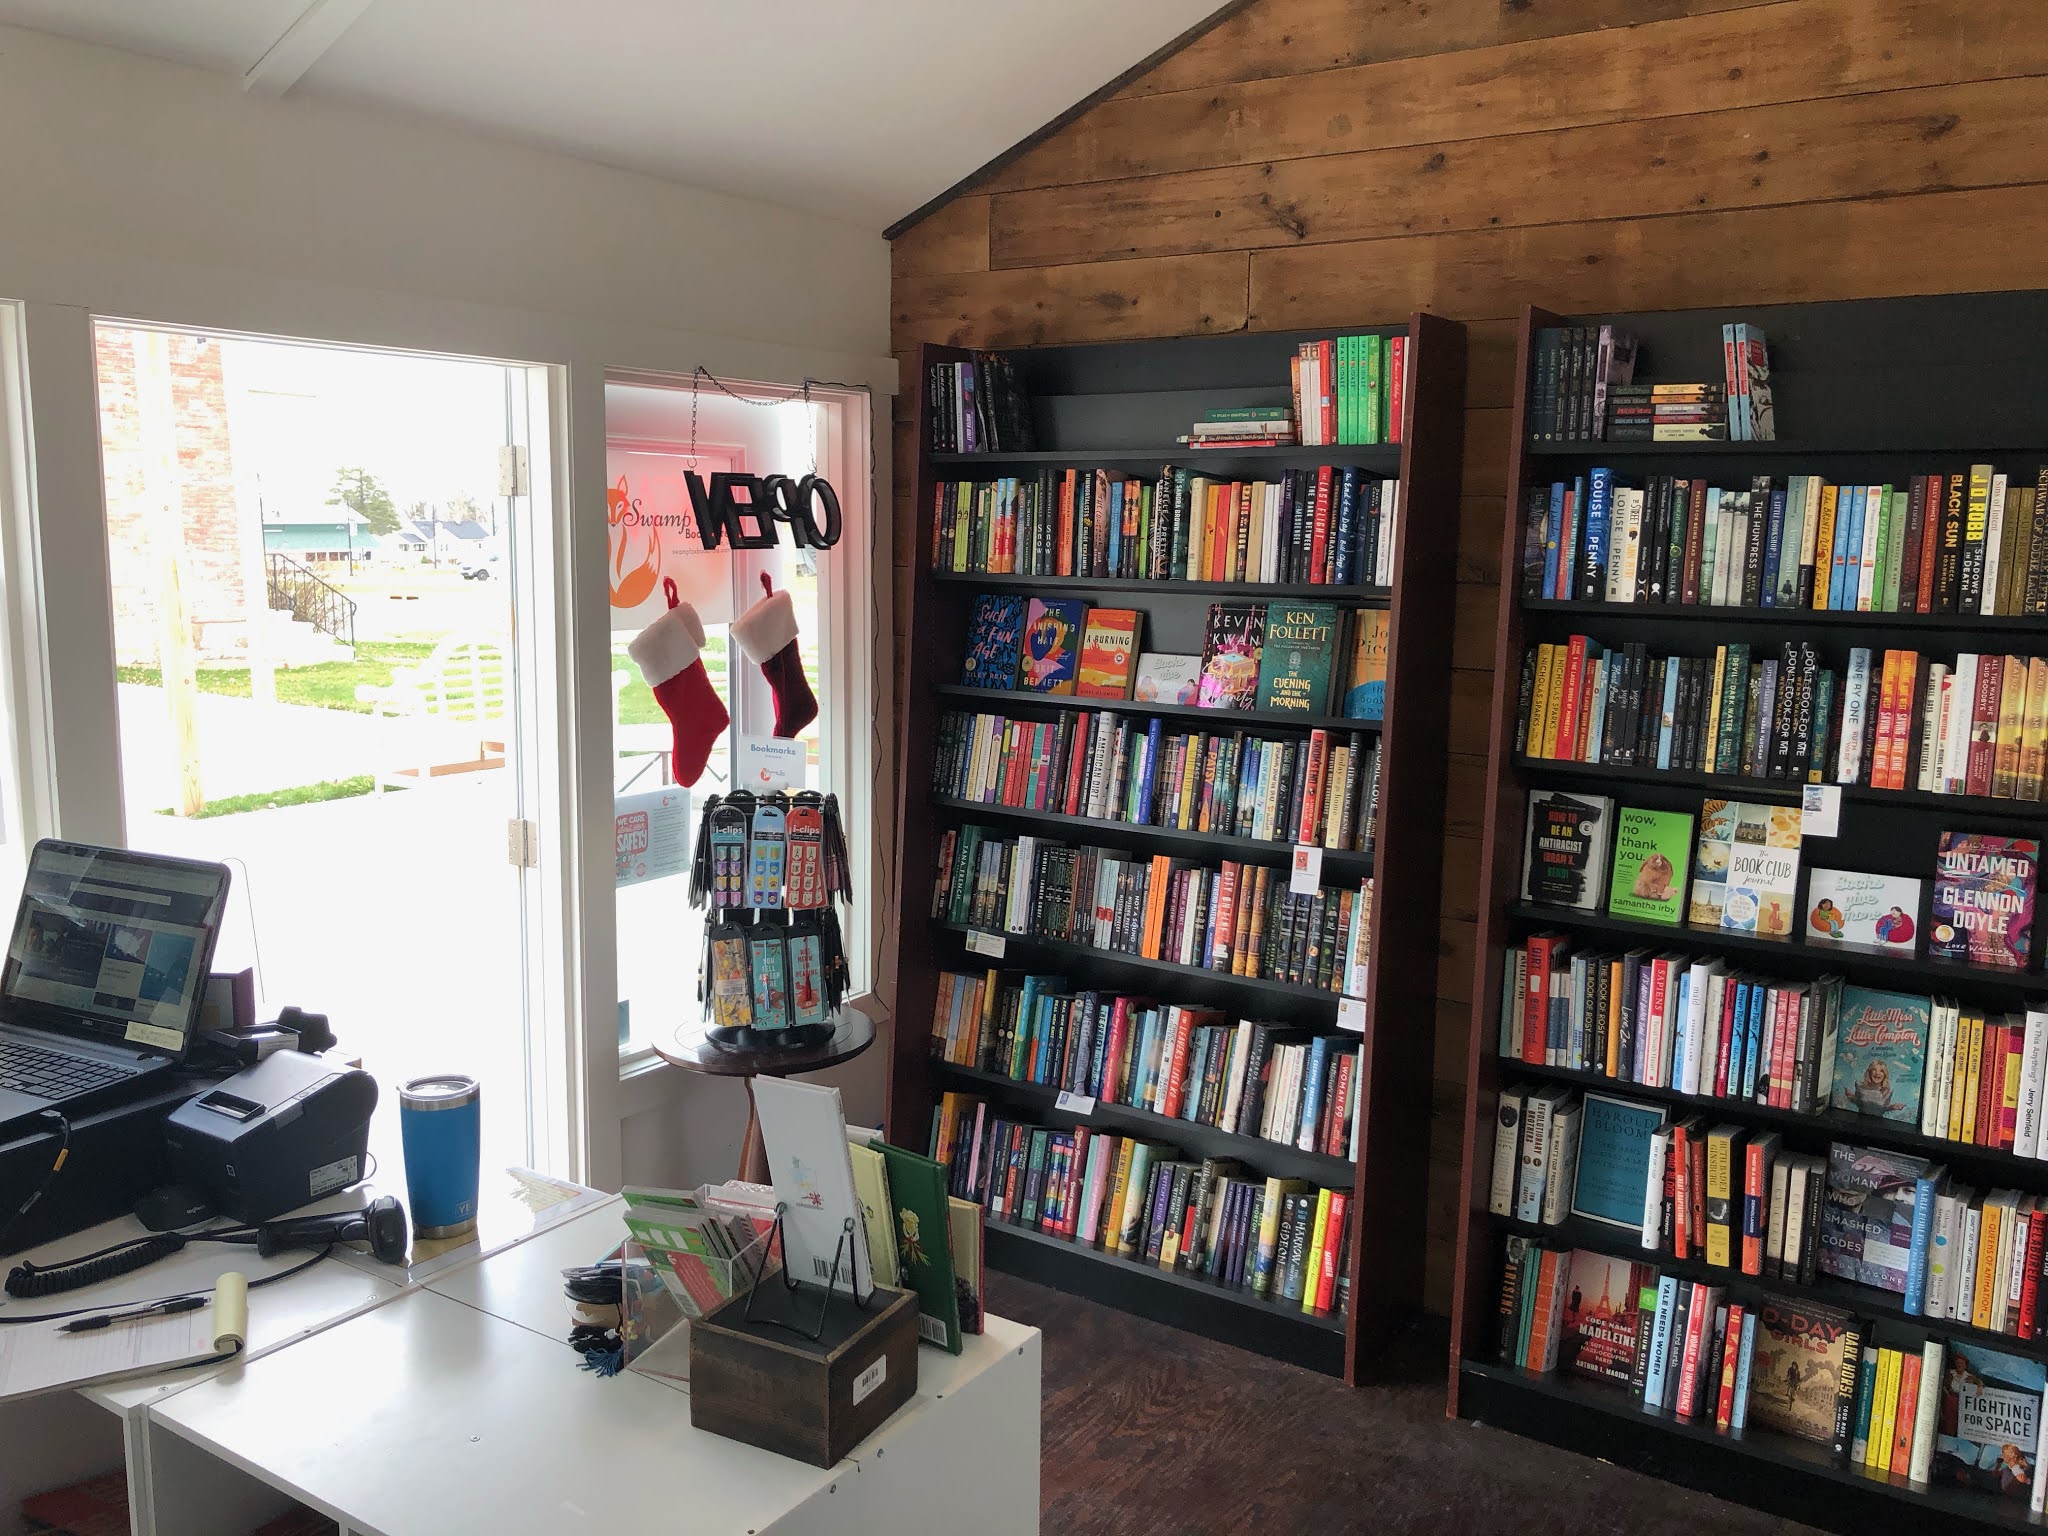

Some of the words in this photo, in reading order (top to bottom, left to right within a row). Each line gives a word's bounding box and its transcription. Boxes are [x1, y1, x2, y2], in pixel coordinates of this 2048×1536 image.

[1162, 477, 1171, 514] JANELLE
[1175, 485, 1183, 508] SANDRA
[1318, 481, 1329, 504] LAST
[1591, 473, 1604, 518] LOUISE
[1948, 474, 1963, 518] BLACK
[2035, 468, 2048, 515] SCHWAB
[622, 498, 691, 535] Swamp
[1614, 494, 1626, 532] LOUISE
[1755, 501, 1764, 519] THE
[1174, 509, 1182, 535] BROWN
[1315, 506, 1327, 540] FLIGHT
[1966, 502, 1987, 541] ROBB
[2034, 518, 2044, 533] OF
[1749, 521, 1761, 570] HUNTRESS
[1945, 521, 1959, 548] SUN
[1586, 536, 1599, 578] PENNY
[2029, 535, 2043, 572] ADDIE
[1611, 548, 1621, 584] PENNY
[1961, 560, 1972, 591] DEATH
[1971, 548, 1982, 594] SHADOWS
[2025, 574, 2039, 612] LARUE
[977, 603, 1007, 623] Such
[1045, 608, 1060, 617] THE
[1214, 615, 1263, 629] KEVIN
[1286, 612, 1315, 625] KEN
[988, 627, 1014, 644] FUN
[1086, 635, 1091, 643] A
[1093, 636, 1130, 646] BURNING
[1212, 634, 1259, 646] KWAN
[1269, 625, 1331, 642] FOLLETT
[973, 643, 999, 659] AGE
[1538, 655, 1548, 699] NICHOLAS
[1854, 655, 1866, 681] ONE
[1273, 679, 1311, 691] EVENING
[1552, 659, 1565, 701] NICHOLAS
[1270, 696, 1310, 712] MORNING
[1729, 685, 1737, 706] DARK
[1979, 678, 1990, 711] GOODBYE
[1534, 701, 1542, 727] SPARKS
[1550, 703, 1559, 730] SPARKS
[1726, 708, 1735, 732] WATER
[1849, 699, 1860, 724] ONE
[1990, 705, 1997, 716] WE
[1879, 712, 1891, 734] SAVING
[1895, 713, 1907, 735] SAVING
[750, 744, 796, 755] Bookmarks
[1851, 731, 1859, 751] RUTH
[1876, 736, 1890, 754] RUBY
[1893, 737, 1905, 754] RUBY
[1094, 737, 1106, 777] AMERICAN
[1875, 755, 1887, 770] KING
[1891, 756, 1903, 771] KING
[1207, 751, 1217, 786] PATSY
[1090, 778, 1099, 799] DIRT
[617, 817, 626, 825] WE
[627, 814, 645, 824] CARE
[715, 825, 743, 834] i-clips
[792, 825, 820, 834] i-clips
[1623, 826, 1639, 835] no
[1624, 813, 1657, 827] wow,
[616, 830, 647, 851] SAFETY
[1551, 825, 1561, 835] BE
[1562, 826, 1573, 837] AN
[1538, 837, 1583, 852] ANTIRACIST
[1621, 837, 1658, 851] thank
[961, 845, 969, 866] TANA
[1619, 850, 1646, 862] you.
[1945, 852, 2029, 878] UNTAMED
[1547, 867, 1569, 879] KENDI
[1733, 857, 1763, 875] BOOK
[1765, 860, 1792, 879] CLUB
[956, 868, 966, 900] FRENCH
[1742, 876, 1775, 887] journal
[1613, 898, 1656, 911] samantha
[1658, 903, 1676, 914] irby
[1942, 887, 2025, 914] GLENNON
[1953, 911, 2010, 935] DOYLE
[795, 969, 818, 977] REAING
[1654, 969, 1665, 1011] SAPIENS
[1857, 1007, 1887, 1024] Little
[1886, 1007, 1914, 1026] Miss
[1175, 1025, 1188, 1063] LEAVERS
[1846, 1027, 1874, 1045] Little
[1874, 1025, 1921, 1047] Compton
[2028, 1046, 2041, 1084] Anything?
[1170, 1084, 1178, 1098] KO
[2025, 1088, 2036, 1108] Jerry
[1592, 1108, 1654, 1128] HAROLD
[2024, 1109, 2034, 1138] Seinfeld
[1594, 1119, 1649, 1140] BLOOM
[1708, 1144, 1717, 1186] GINSBURG
[1833, 1149, 1856, 1163] THE
[1719, 1162, 1727, 1193] BADER
[1830, 1169, 1879, 1190] WOMAN
[1828, 1191, 1857, 1206] WHO
[1252, 1204, 1260, 1233] MORTON
[1823, 1213, 1881, 1235] SMASHED
[1278, 1221, 1292, 1265] GIDEON
[1291, 1221, 1306, 1266] HARROW
[1821, 1234, 1862, 1252] CODES
[1988, 1223, 1996, 1254] QUEENS
[1986, 1255, 1994, 1265] OF
[1663, 1284, 1671, 1304] YALE
[1981, 1266, 1992, 1312] ANIMATION
[1586, 1316, 1606, 1326] CODE
[1608, 1322, 1633, 1334] NAME
[1658, 1306, 1668, 1338] NEEDS
[1763, 1307, 1843, 1341] D-DAY
[1579, 1323, 1636, 1349] MADELEINE
[1641, 1320, 1650, 1351] RADIUM
[1771, 1329, 1828, 1354] GIRLS
[1653, 1340, 1664, 1376] WOMEN
[1843, 1331, 1860, 1363] DARK
[1575, 1359, 1598, 1372] ARTHUR
[1606, 1368, 1629, 1381] MAGIDA
[1595, 1356, 1613, 1365] PARIS
[1638, 1352, 1646, 1375] GIRLS
[1839, 1364, 1857, 1399] HORSE
[1964, 1395, 2032, 1421] FIGHTING
[1964, 1413, 1982, 1427] FOR
[1985, 1417, 2031, 1438] SPACE
